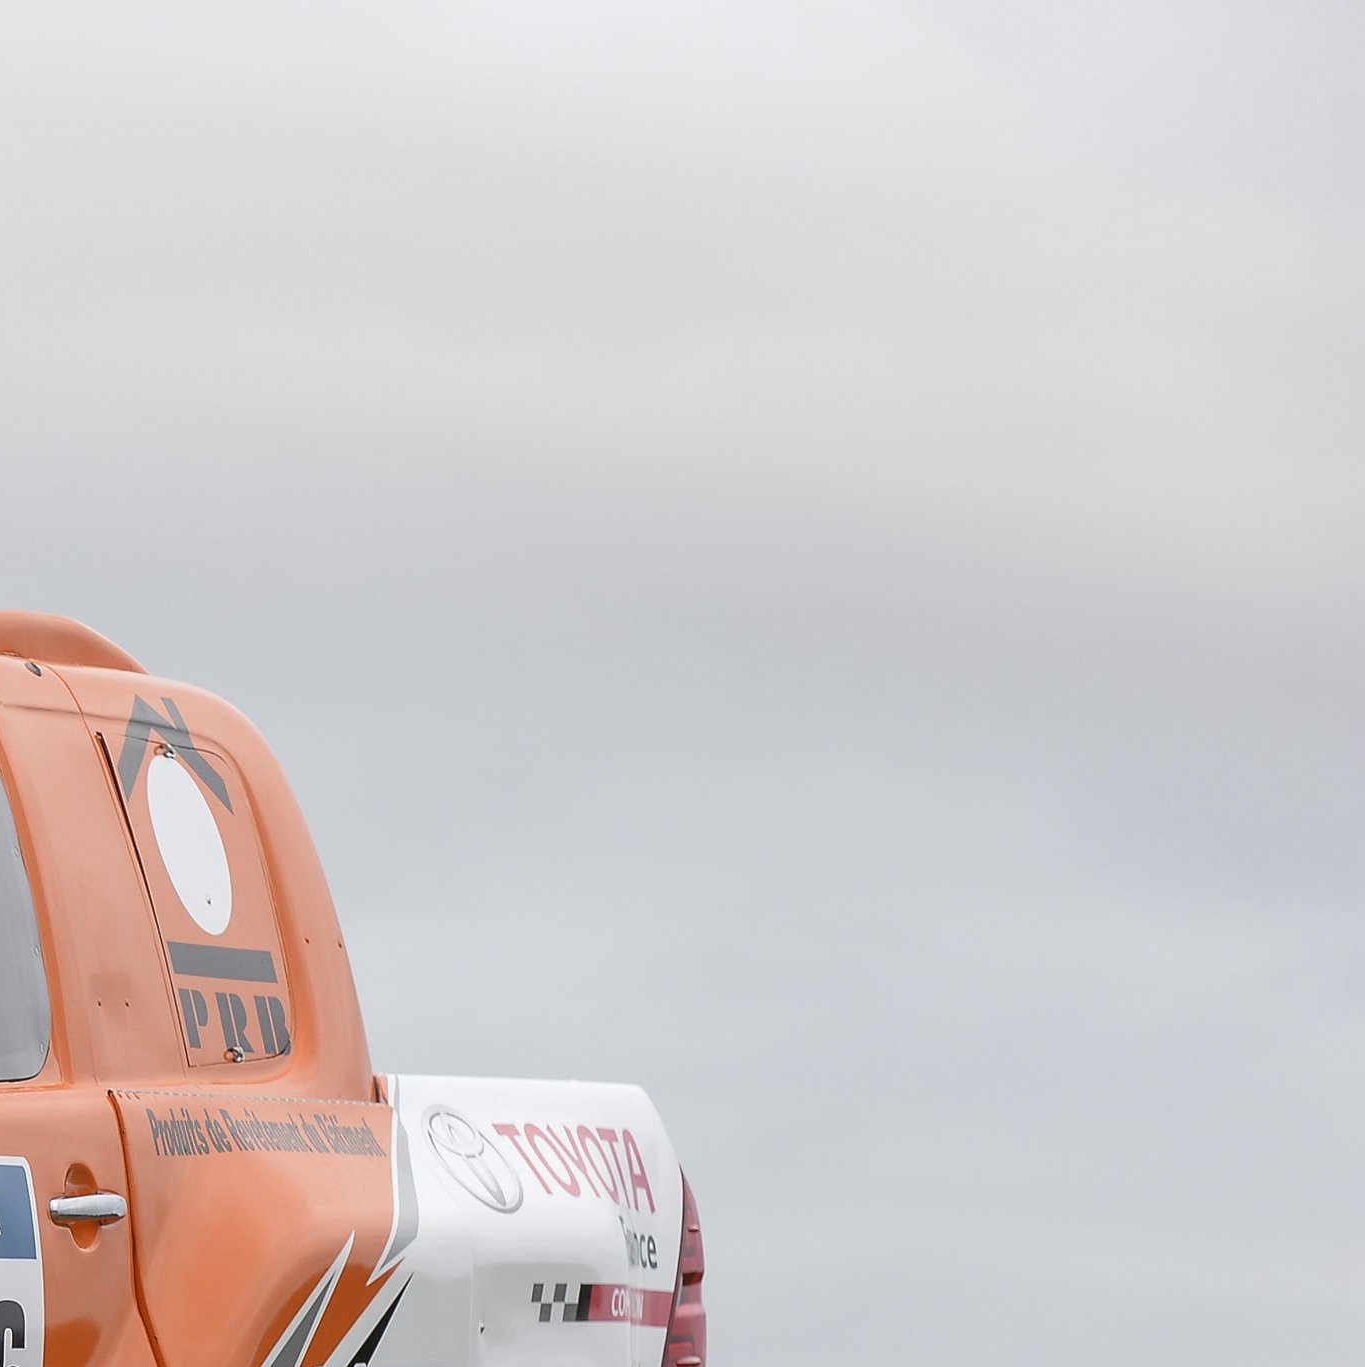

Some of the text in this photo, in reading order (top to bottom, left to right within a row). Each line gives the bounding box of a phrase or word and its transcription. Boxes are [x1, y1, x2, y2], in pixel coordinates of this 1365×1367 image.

[178, 987, 291, 1056] PRB
[146, 1107, 210, 1156] Produits
[204, 1108, 232, 1153] de
[494, 1122, 656, 1213] TOYOTA
